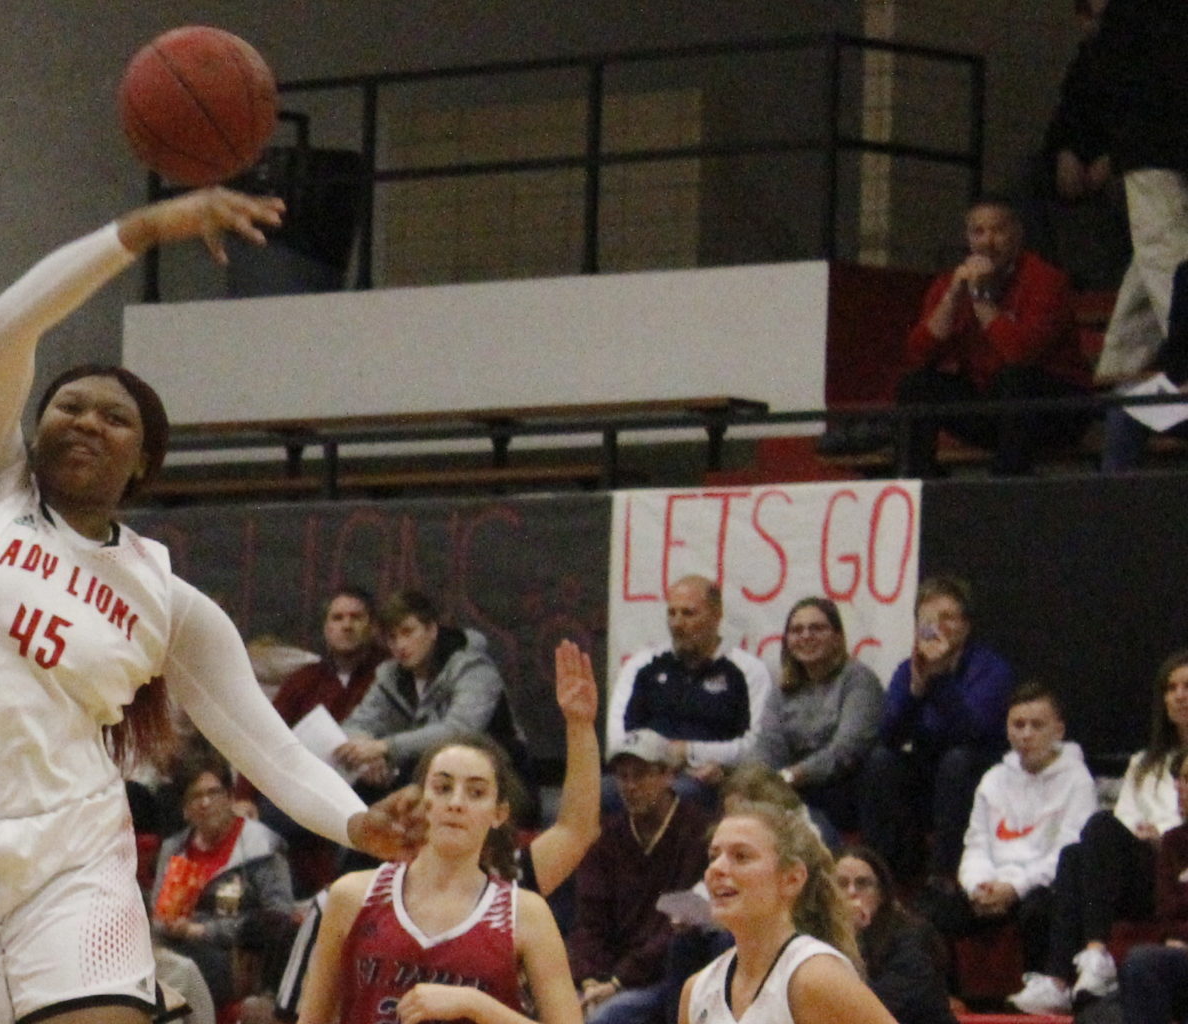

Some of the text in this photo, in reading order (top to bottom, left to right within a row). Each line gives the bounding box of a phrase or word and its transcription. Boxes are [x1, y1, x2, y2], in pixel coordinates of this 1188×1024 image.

[621, 485, 915, 605] LETS GO
[8, 602, 74, 670] 45
